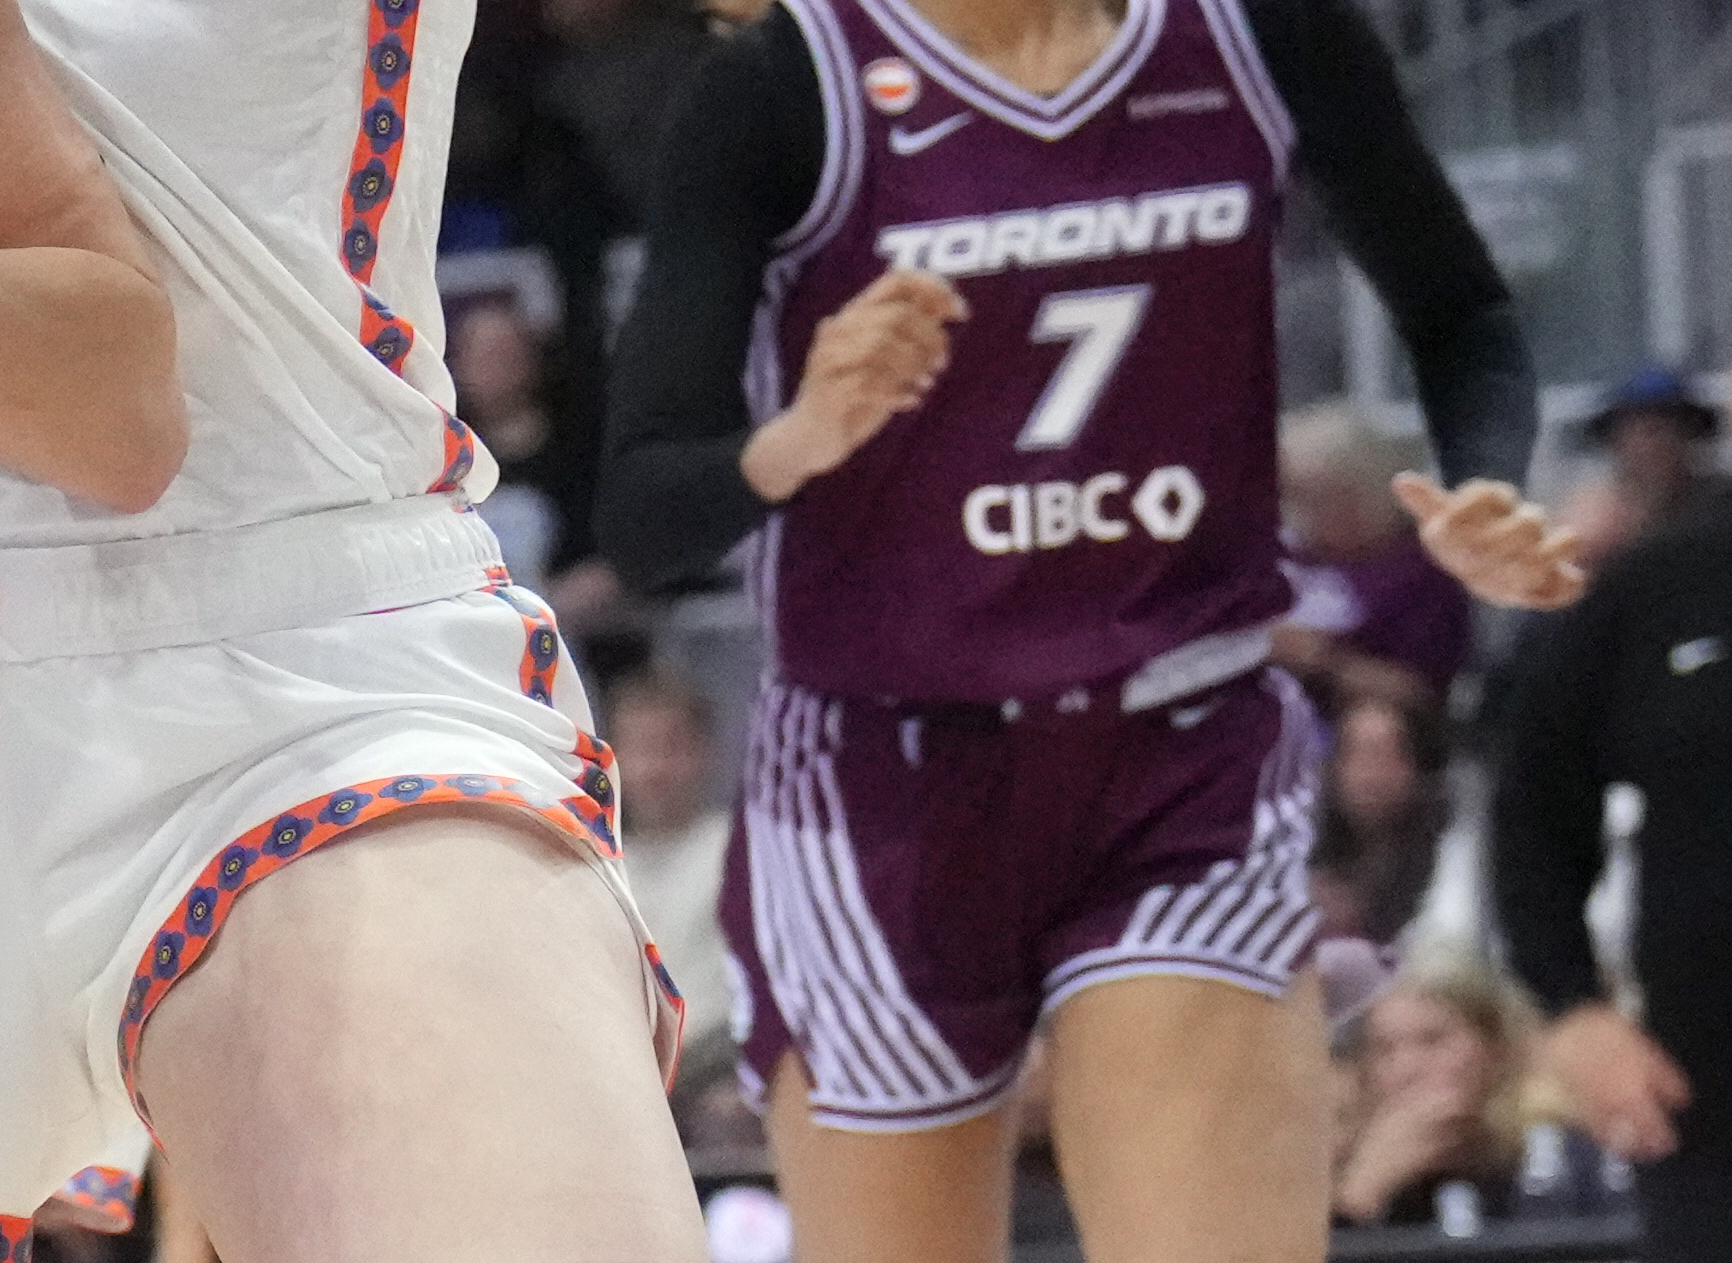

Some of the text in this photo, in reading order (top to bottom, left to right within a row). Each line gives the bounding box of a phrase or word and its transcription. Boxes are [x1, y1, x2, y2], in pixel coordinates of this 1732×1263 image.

[872, 180, 1252, 278] TORONTO
[1014, 282, 1154, 452] 7
[962, 470, 1130, 554] CIBC
